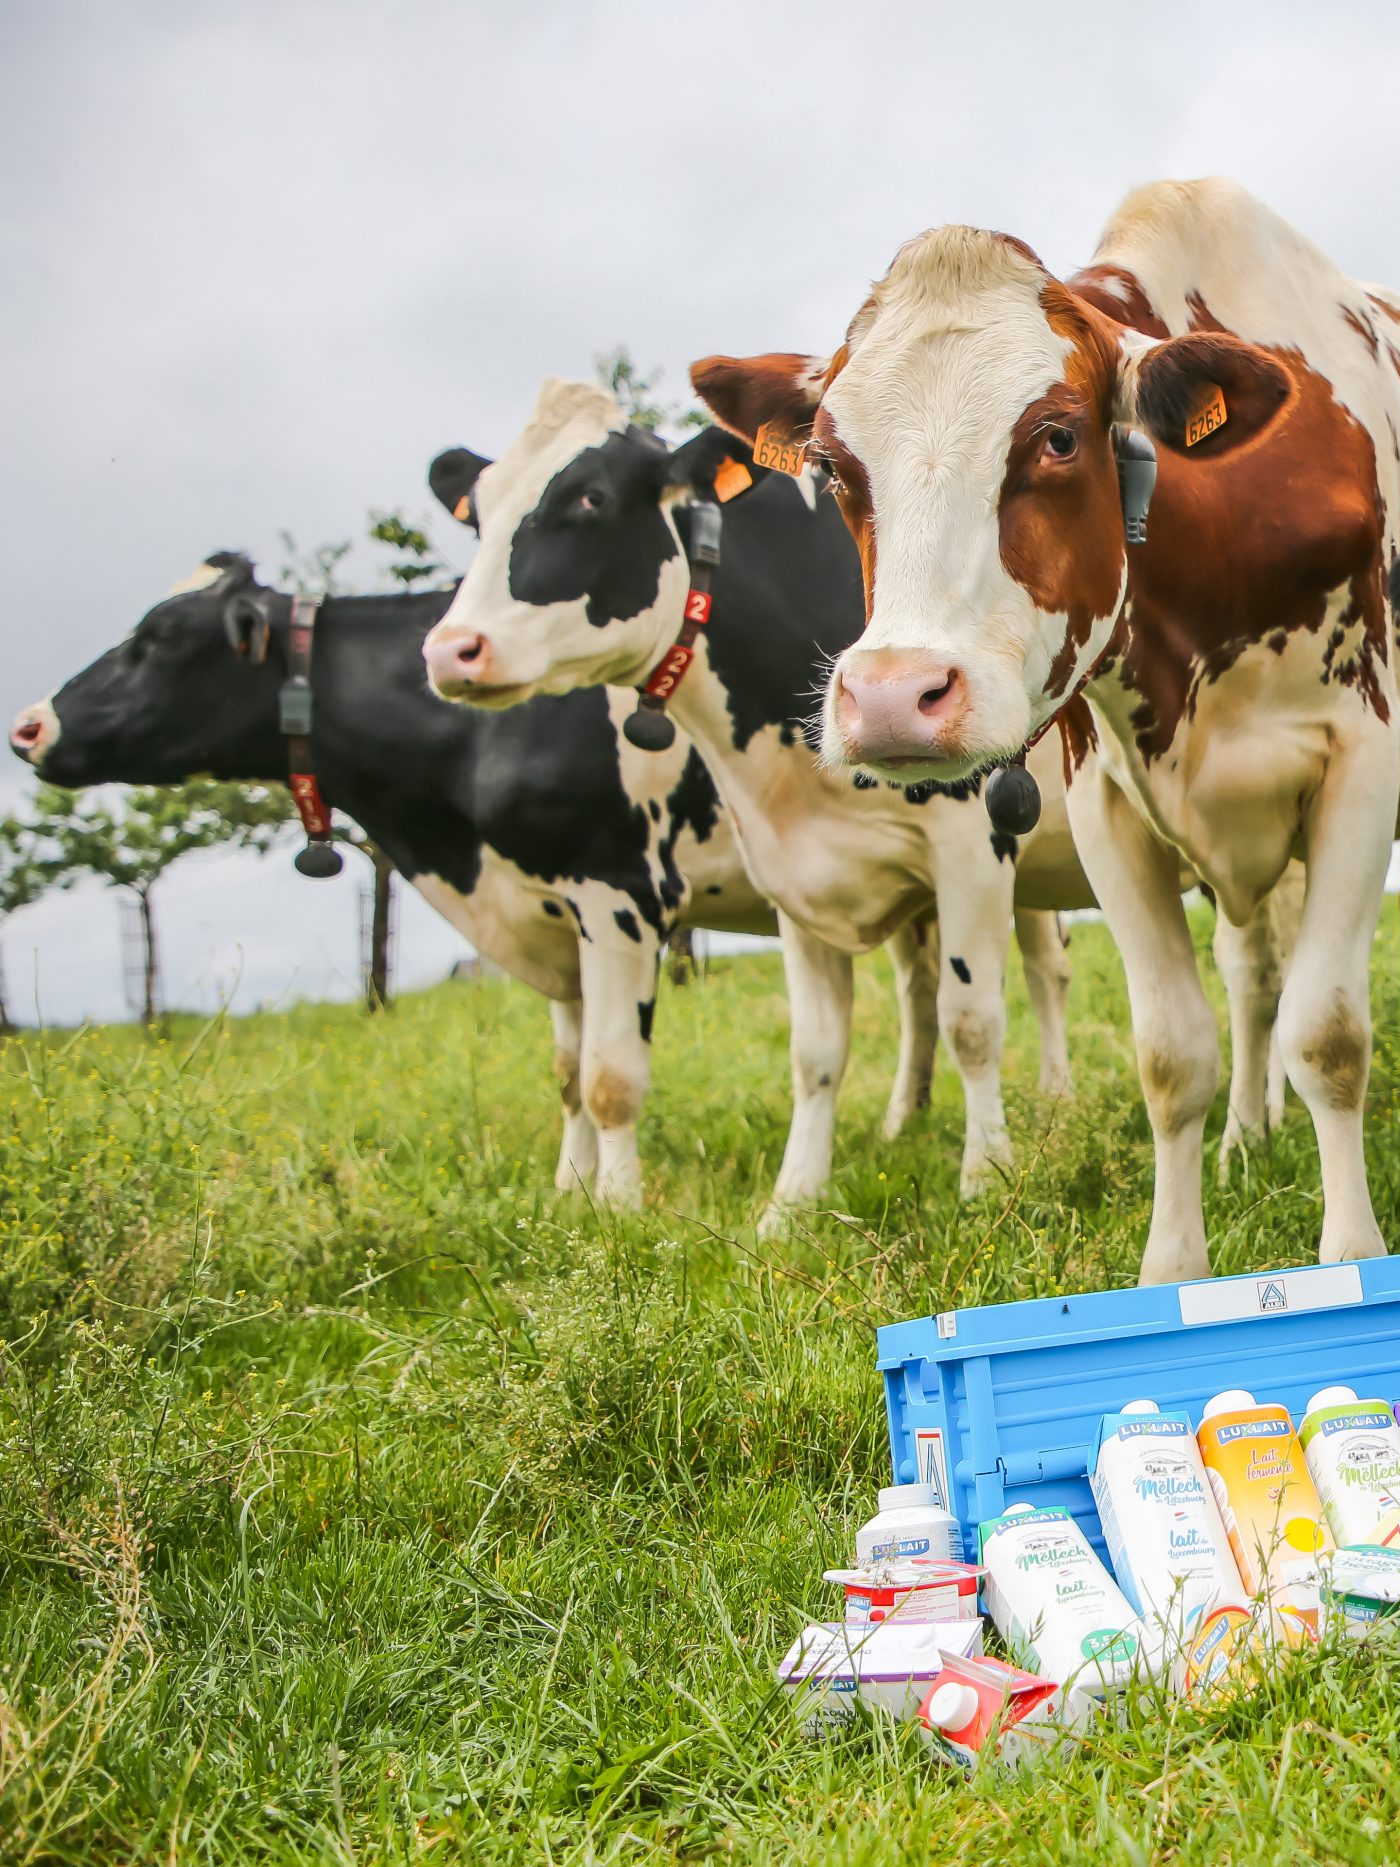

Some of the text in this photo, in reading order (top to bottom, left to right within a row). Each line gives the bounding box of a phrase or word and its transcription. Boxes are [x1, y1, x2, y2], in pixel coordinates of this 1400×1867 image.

[1189, 402, 1222, 443] 6263
[759, 442, 800, 474] 6263
[689, 594, 708, 620] 2
[1263, 1300, 1284, 1309] ALDI
[1121, 1422, 1186, 1436] LUXLAIT
[1220, 1421, 1287, 1439] LUXLAIT
[1325, 1415, 1388, 1432] LUXLAIT
[1252, 1448, 1278, 1465] Lait
[1133, 1475, 1204, 1502] Mëllech
[997, 1512, 1065, 1531] LUXLAIT
[873, 1540, 928, 1557] LULAIT
[1015, 1545, 1089, 1572] Mëllech
[817, 1640, 861, 1648] YAOUR
